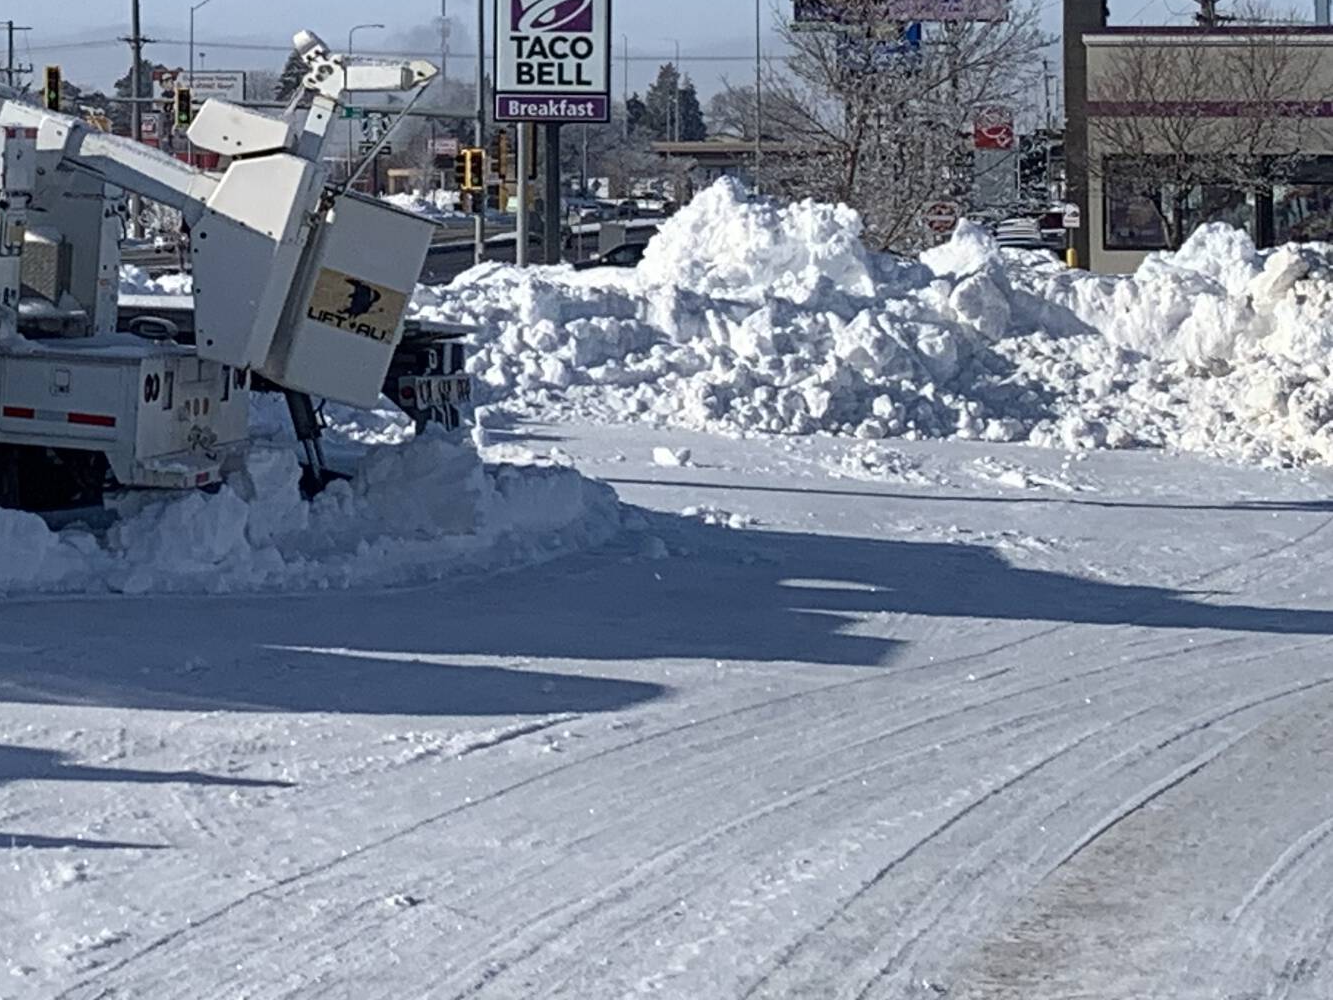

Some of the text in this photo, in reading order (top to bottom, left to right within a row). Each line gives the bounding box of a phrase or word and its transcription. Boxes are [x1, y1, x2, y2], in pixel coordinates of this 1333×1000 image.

[510, 35, 593, 60] TACO
[516, 62, 592, 86] BELL
[508, 99, 594, 117] Breakfast
